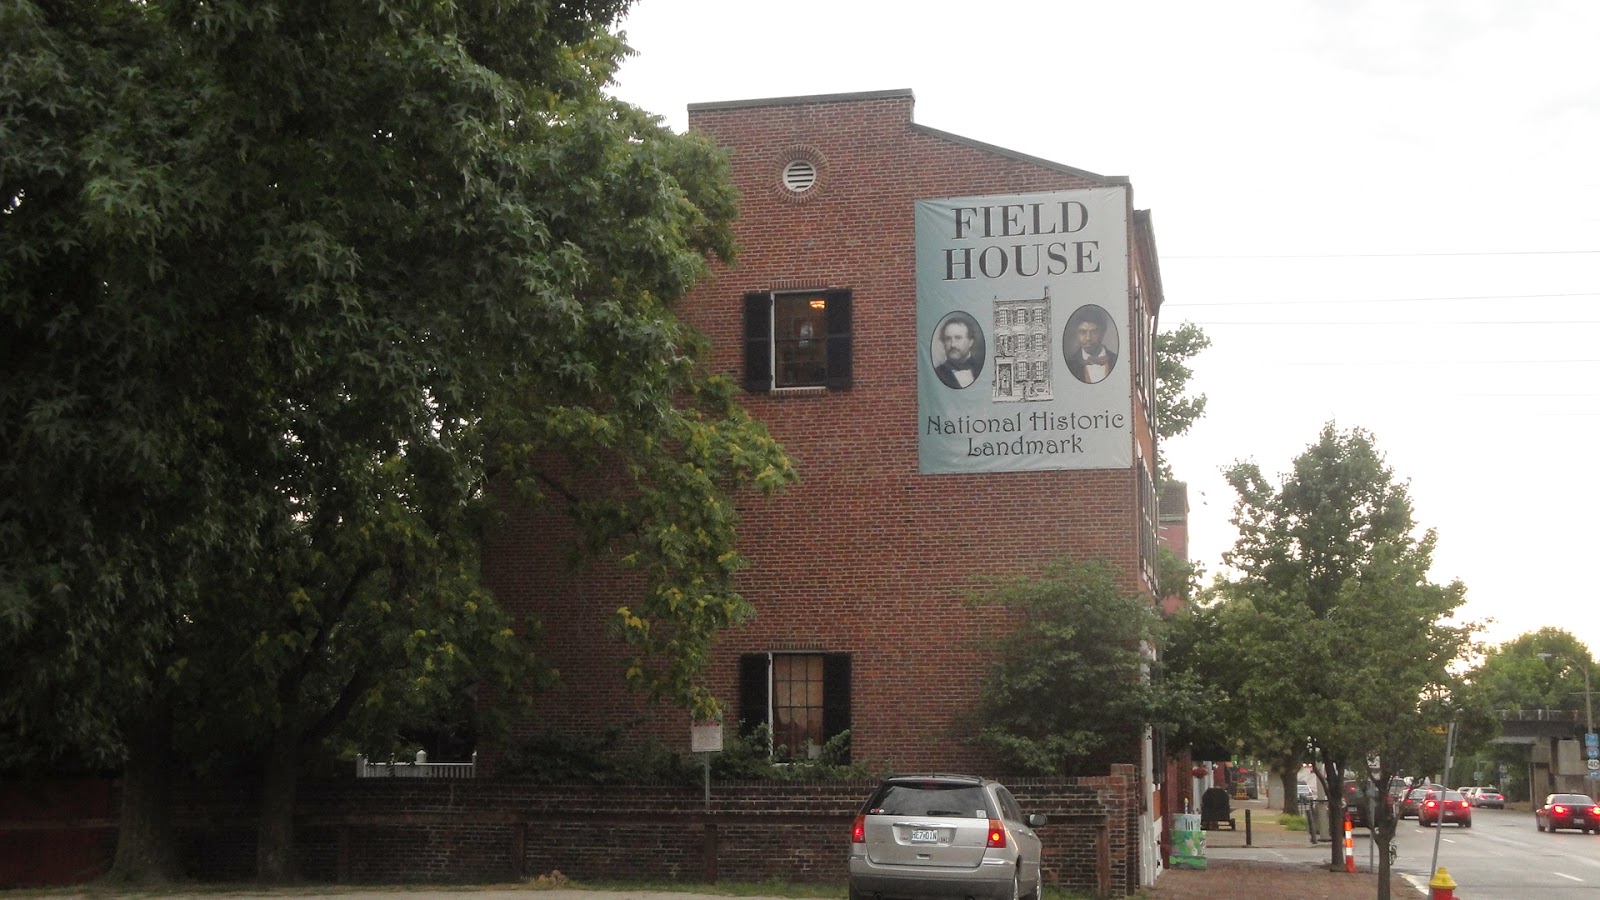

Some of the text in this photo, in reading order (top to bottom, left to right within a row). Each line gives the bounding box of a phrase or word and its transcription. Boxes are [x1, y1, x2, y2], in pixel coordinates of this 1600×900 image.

[951, 200, 1089, 240] FIELD
[942, 240, 1101, 281] HOUSE
[927, 410, 1124, 435] National Historic
[967, 434, 1084, 457] Landmark
